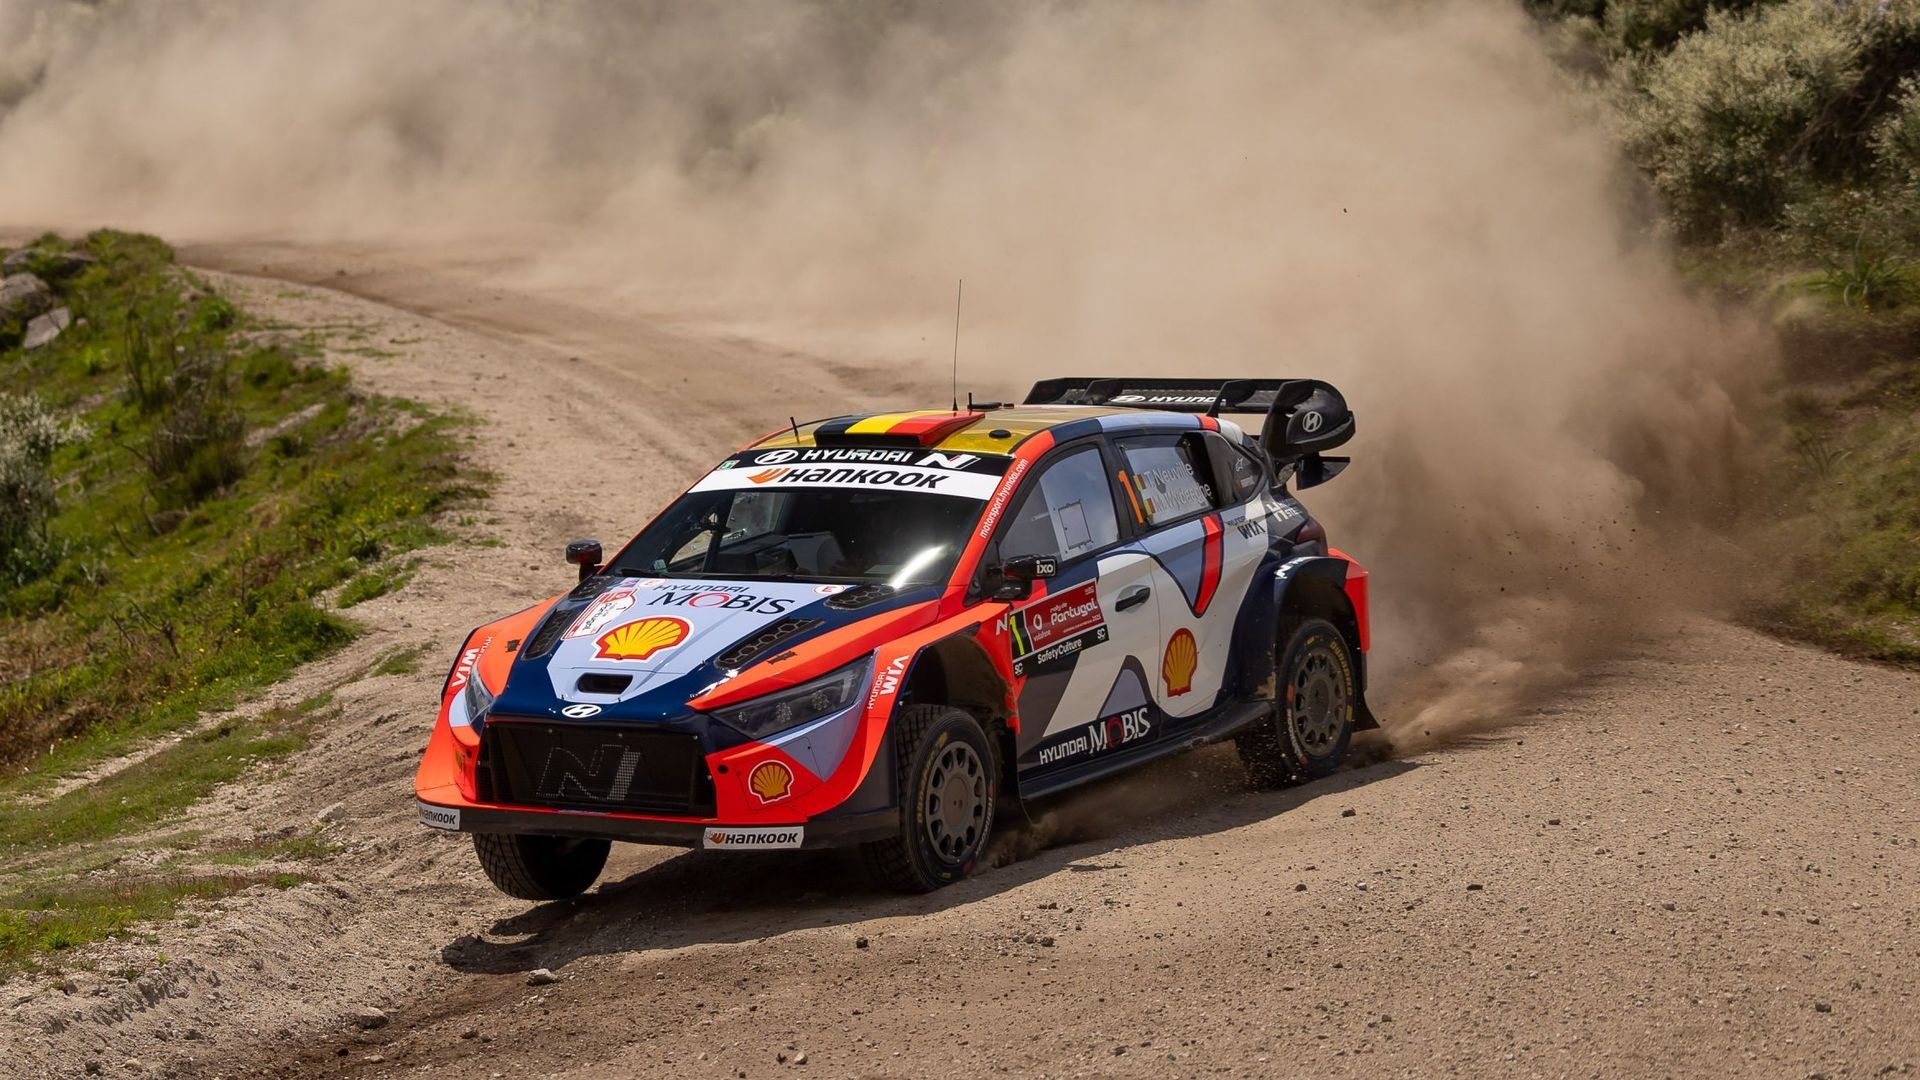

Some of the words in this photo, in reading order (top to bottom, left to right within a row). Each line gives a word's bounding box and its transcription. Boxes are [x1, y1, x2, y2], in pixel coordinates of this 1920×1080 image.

[801, 449, 913, 462] HYUNDAI
[914, 452, 981, 470] N
[980, 458, 1029, 539] motorsport.hyundai.com
[1118, 470, 1144, 524] 1
[1036, 560, 1054, 575] ixo
[648, 592, 796, 615] MOBIS
[653, 584, 750, 593] HYUNDAI
[1050, 597, 1098, 626] Portugal
[1009, 615, 1025, 656] 1
[1037, 638, 1083, 665] SafetyCulture
[867, 671, 887, 710] HYUNDAI
[879, 655, 910, 695] WIA
[1039, 735, 1088, 765] HYUNDAI
[1088, 707, 1151, 755] MOBIS
